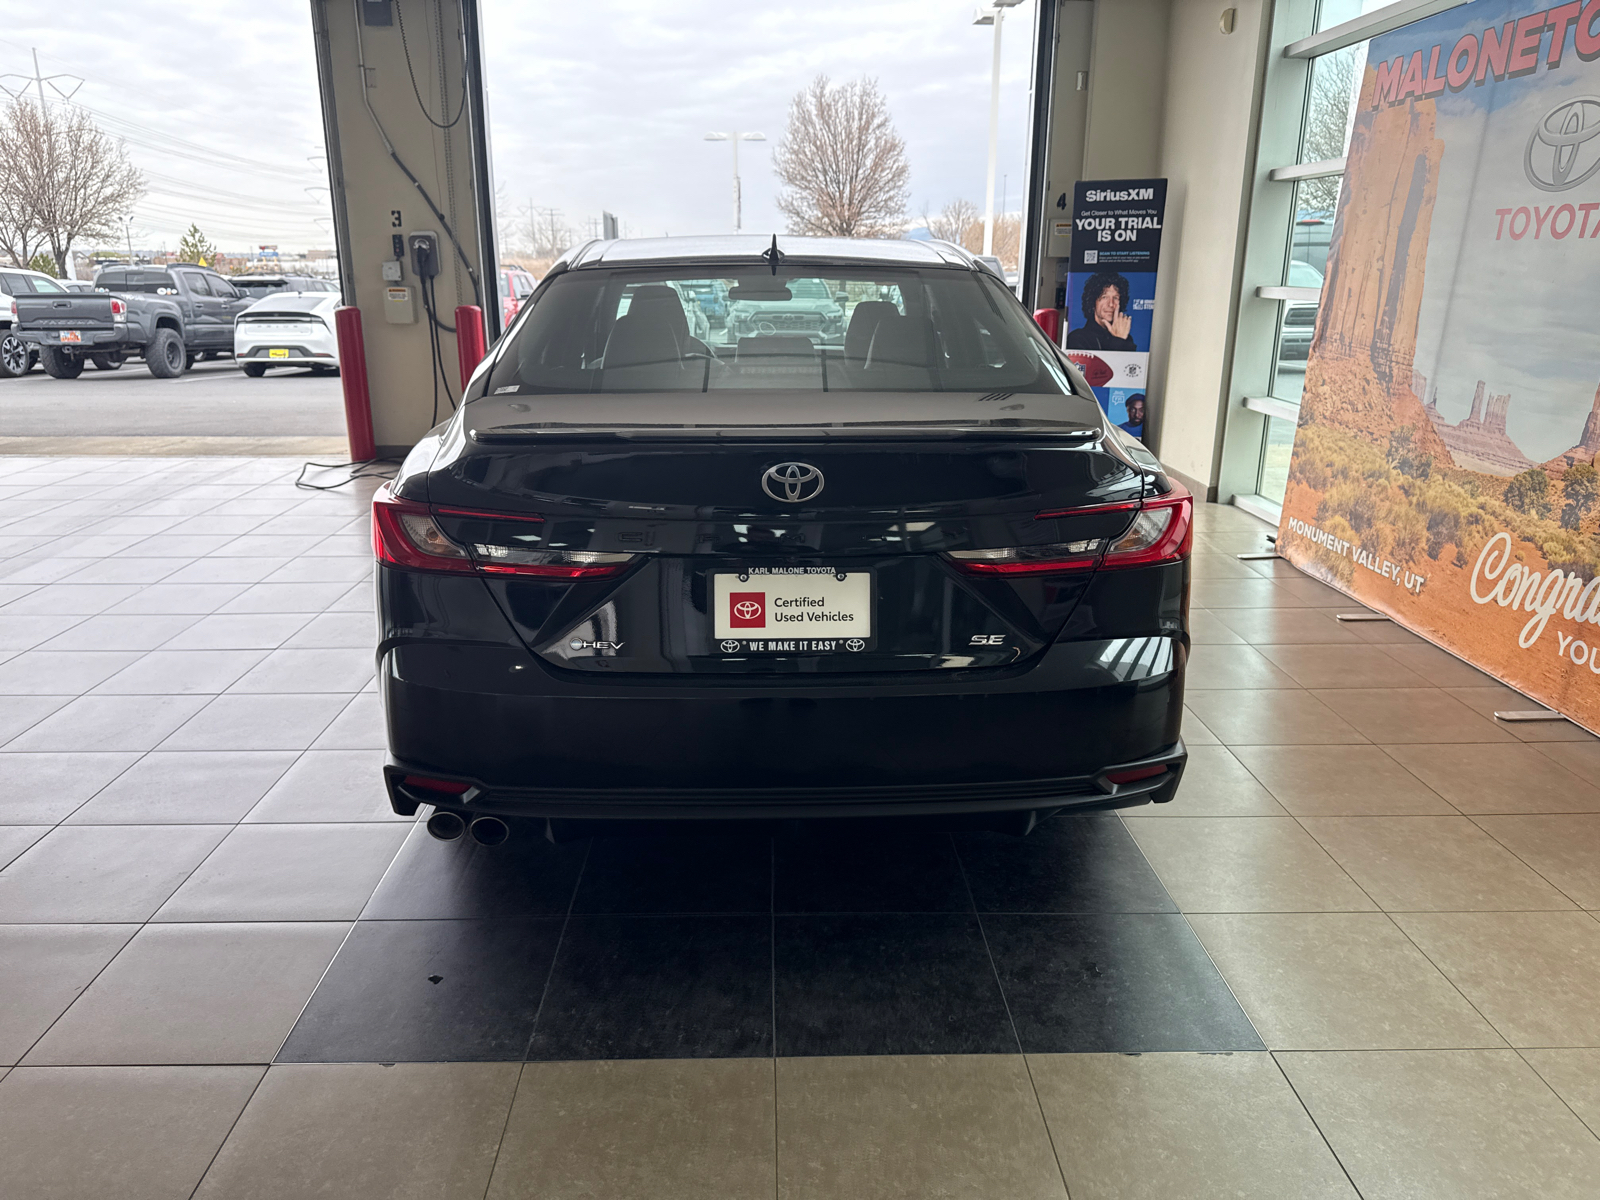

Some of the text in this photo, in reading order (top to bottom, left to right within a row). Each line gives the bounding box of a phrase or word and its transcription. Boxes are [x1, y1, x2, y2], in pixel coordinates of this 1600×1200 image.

[1085, 188, 1154, 201] SiriusXM
[1056, 192, 1067, 211] 4
[391, 210, 402, 228] 3
[1075, 217, 1115, 230] YOUR
[1118, 216, 1162, 230] TRIAL
[1097, 229, 1137, 242] IS ON
[1287, 516, 1426, 594] MONUMENT VALLEY, UT
[748, 566, 837, 575] KARL MALONE TOYOTA
[774, 596, 825, 608] Certified
[774, 611, 854, 623] Used Vehicles
[583, 640, 626, 650] HEV
[749, 640, 837, 651] WE MAKE IT EASY
[968, 634, 1006, 646] SE
